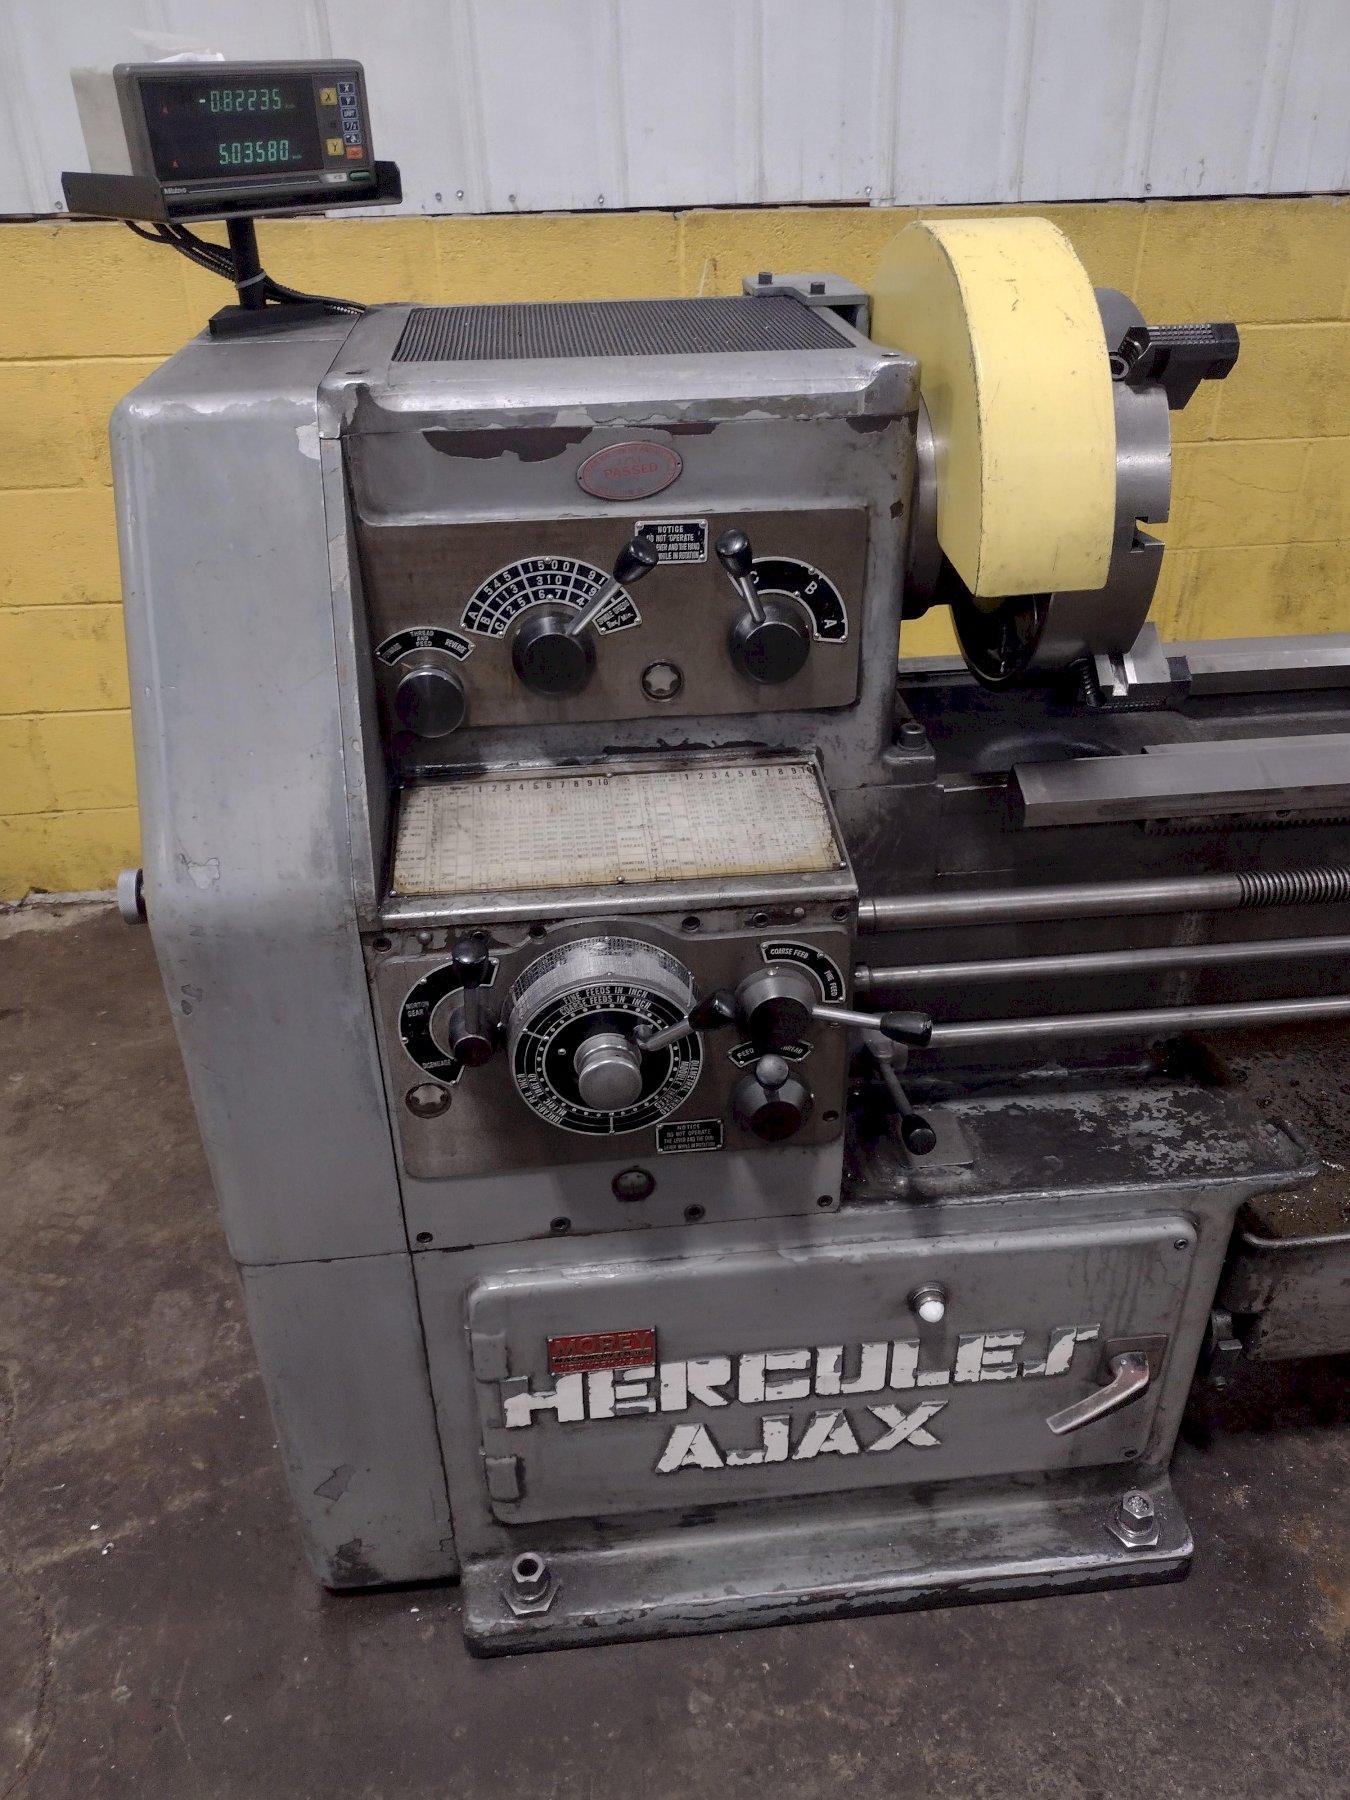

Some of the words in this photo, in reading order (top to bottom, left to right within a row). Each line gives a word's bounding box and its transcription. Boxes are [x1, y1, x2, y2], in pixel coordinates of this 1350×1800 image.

[325, 92, 332, 102] X
[219, 140, 289, 165] 5.03580
[332, 142, 338, 152] Y
[604, 462, 658, 478] PASSED
[657, 525, 684, 533] NOTICE
[668, 533, 694, 542] OPERATE
[527, 560, 570, 572] 1500
[484, 571, 512, 596] 545
[536, 576, 562, 585] 310
[538, 588, 562, 599] 67
[582, 583, 598, 597] 19
[804, 581, 817, 594] B
[495, 584, 518, 605] 113
[576, 595, 586, 606] 4
[506, 597, 526, 615] 25
[468, 611, 478, 620] A
[481, 614, 492, 625] B
[494, 621, 504, 631] C
[824, 619, 837, 629] A
[698, 772, 704, 780] 2
[711, 771, 717, 779] 3
[770, 948, 793, 956] COARSE
[793, 950, 809, 959] FEED
[563, 993, 582, 1004] FINE
[585, 987, 610, 997] FEEDS
[628, 988, 648, 999] INCH
[830, 982, 838, 997] FEED
[559, 999, 588, 1016] COARSE
[590, 995, 612, 1004] FEEDS
[616, 995, 625, 1003] IN
[631, 998, 651, 1010] INCH
[737, 1047, 755, 1059] FEED
[503, 1324, 1101, 1428] HERCULES
[655, 1400, 949, 1474] AJAX
